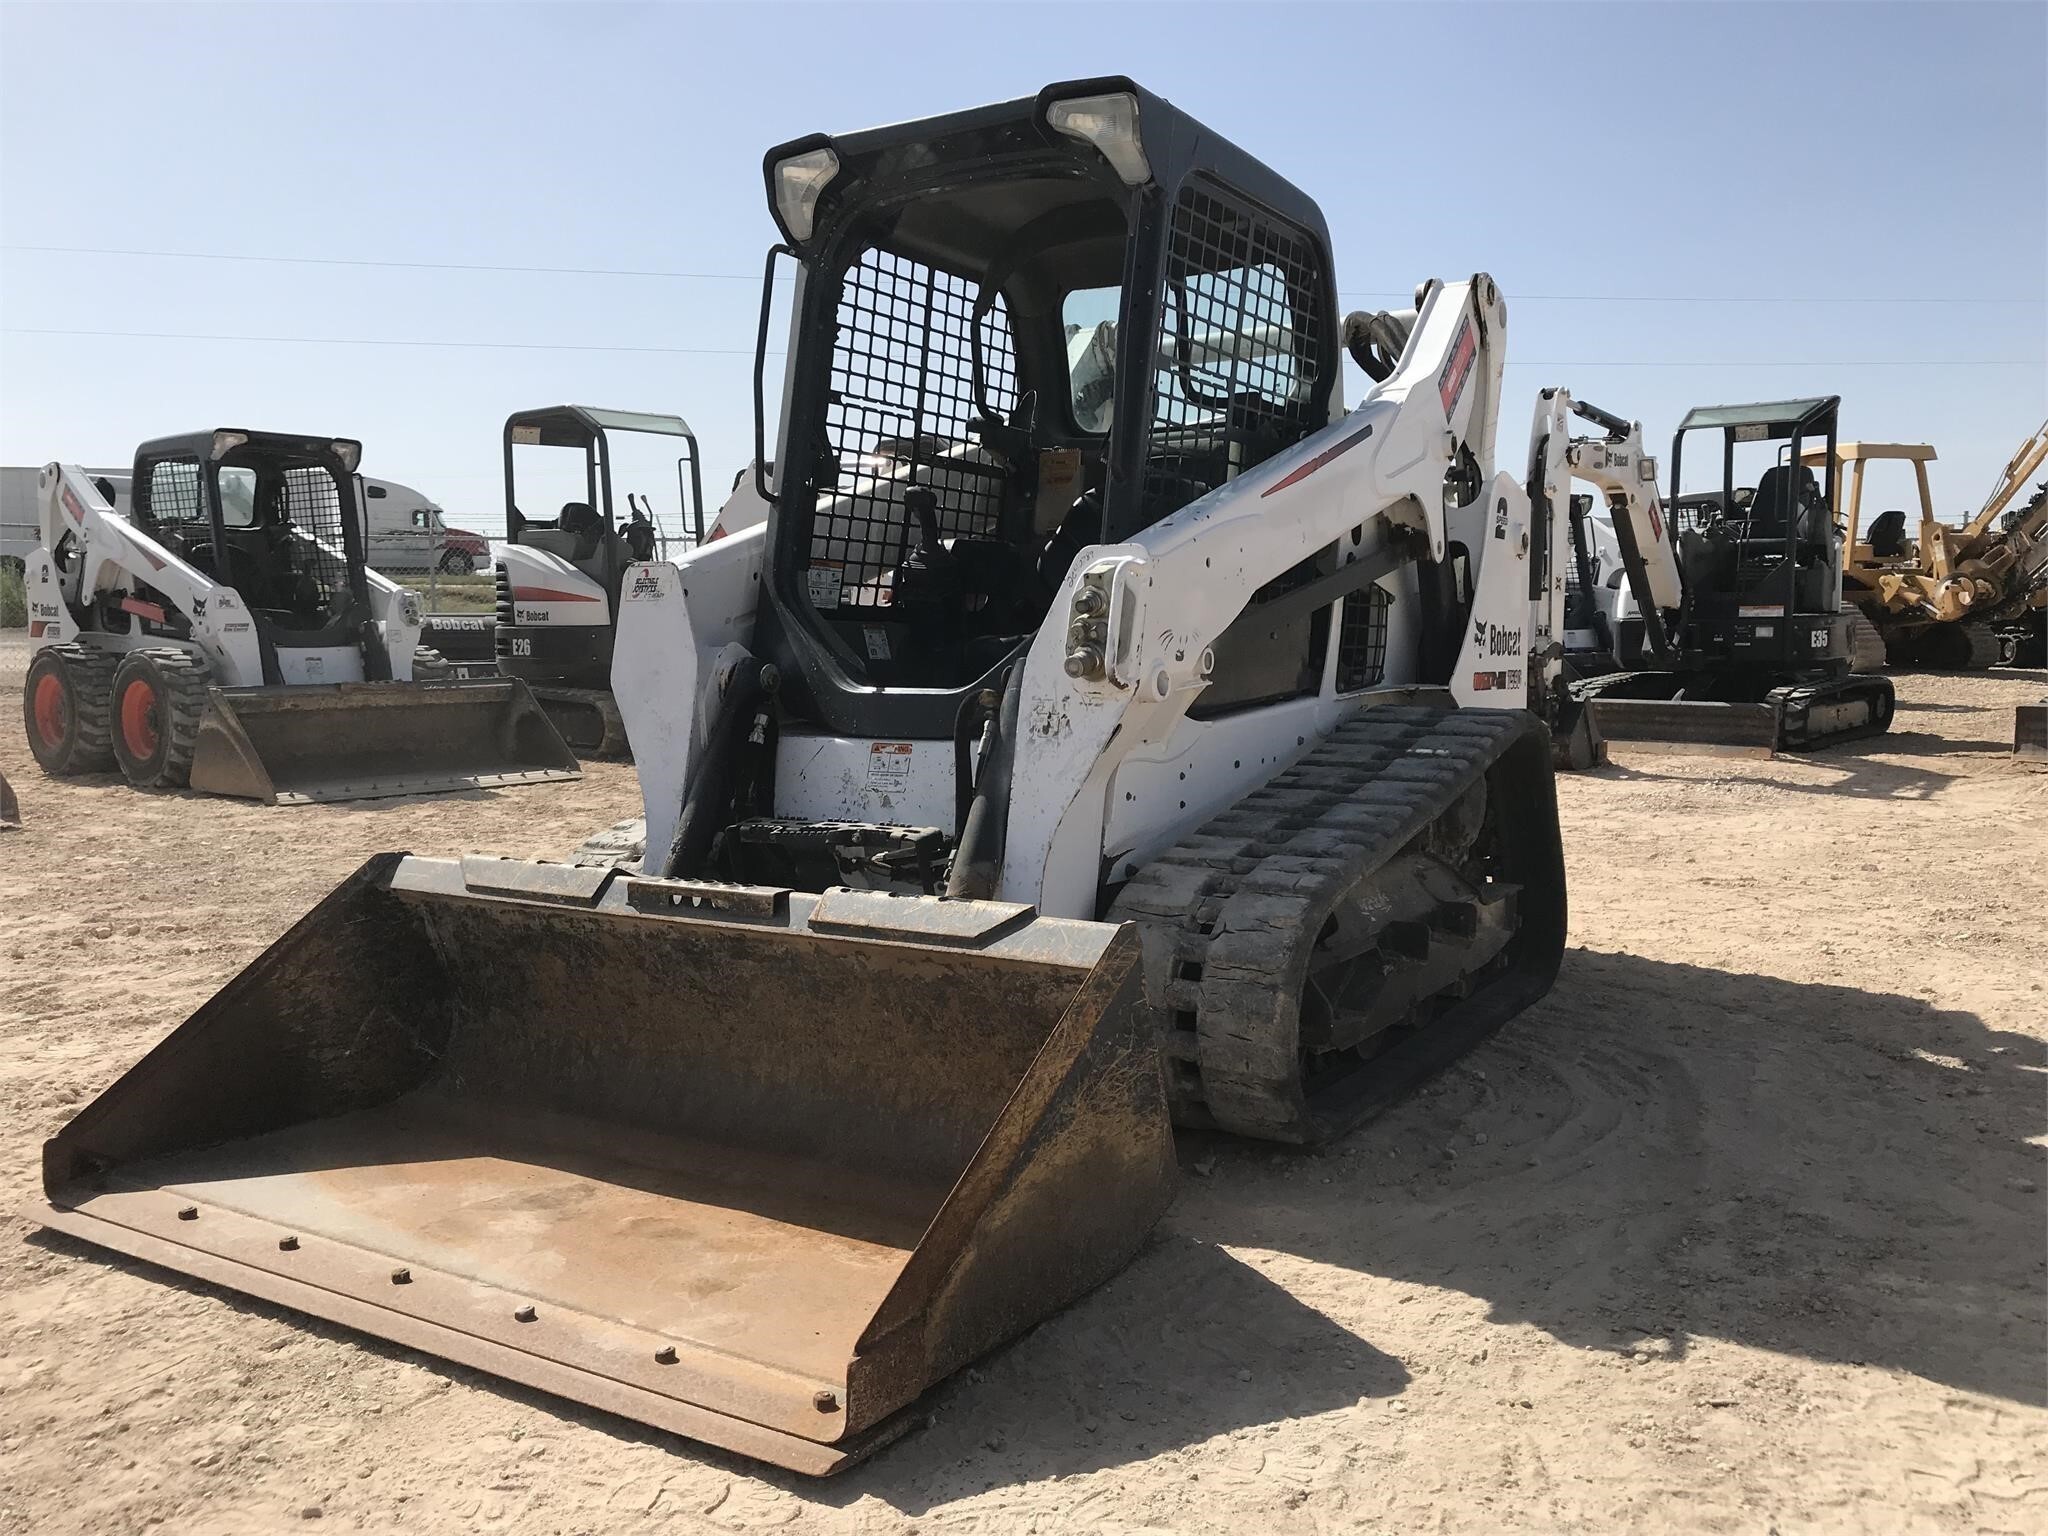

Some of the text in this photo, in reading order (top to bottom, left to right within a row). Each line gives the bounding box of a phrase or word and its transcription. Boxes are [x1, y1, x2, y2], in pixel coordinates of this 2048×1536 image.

[1613, 453, 1629, 467] Bobcat
[40, 603, 59, 617] Bobcat
[526, 610, 550, 623] Bobcat
[431, 618, 486, 632] Bobcat
[1489, 624, 1522, 657] Bobcat
[1811, 630, 1829, 648] E35
[512, 638, 532, 656] E26
